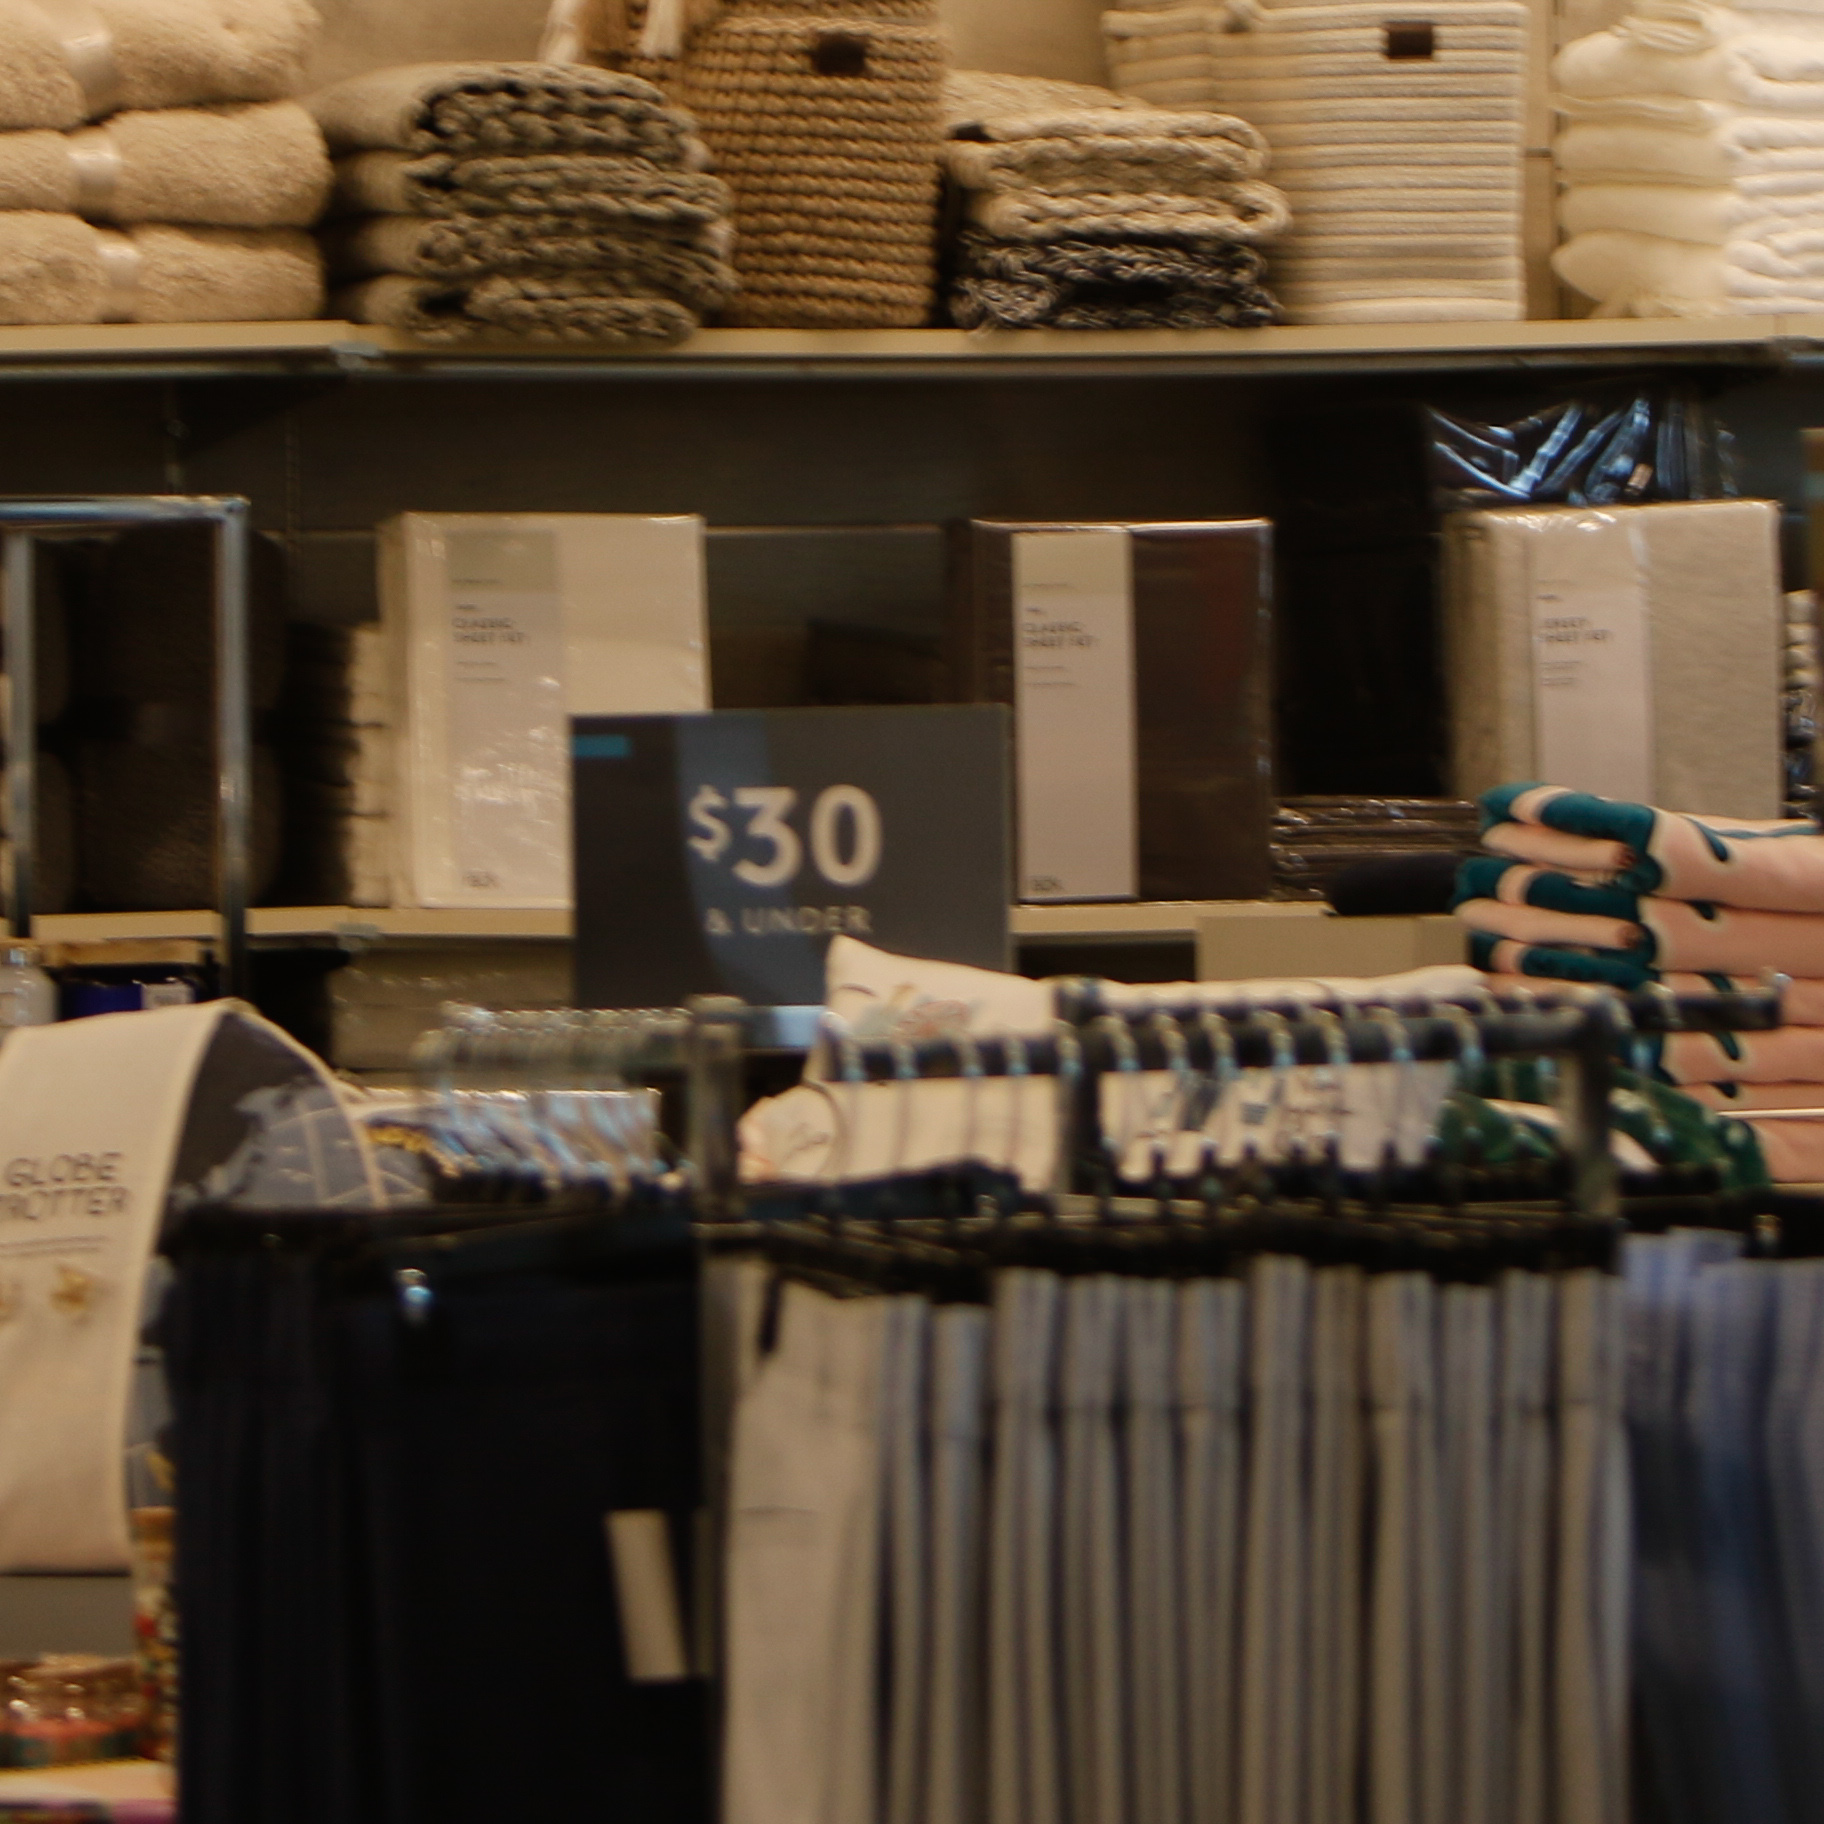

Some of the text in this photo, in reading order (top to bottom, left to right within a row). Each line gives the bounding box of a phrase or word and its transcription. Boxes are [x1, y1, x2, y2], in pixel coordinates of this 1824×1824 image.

[686, 783, 883, 888] $30
[703, 905, 874, 937] & UNDER
[4, 1151, 125, 1188] GLOBE
